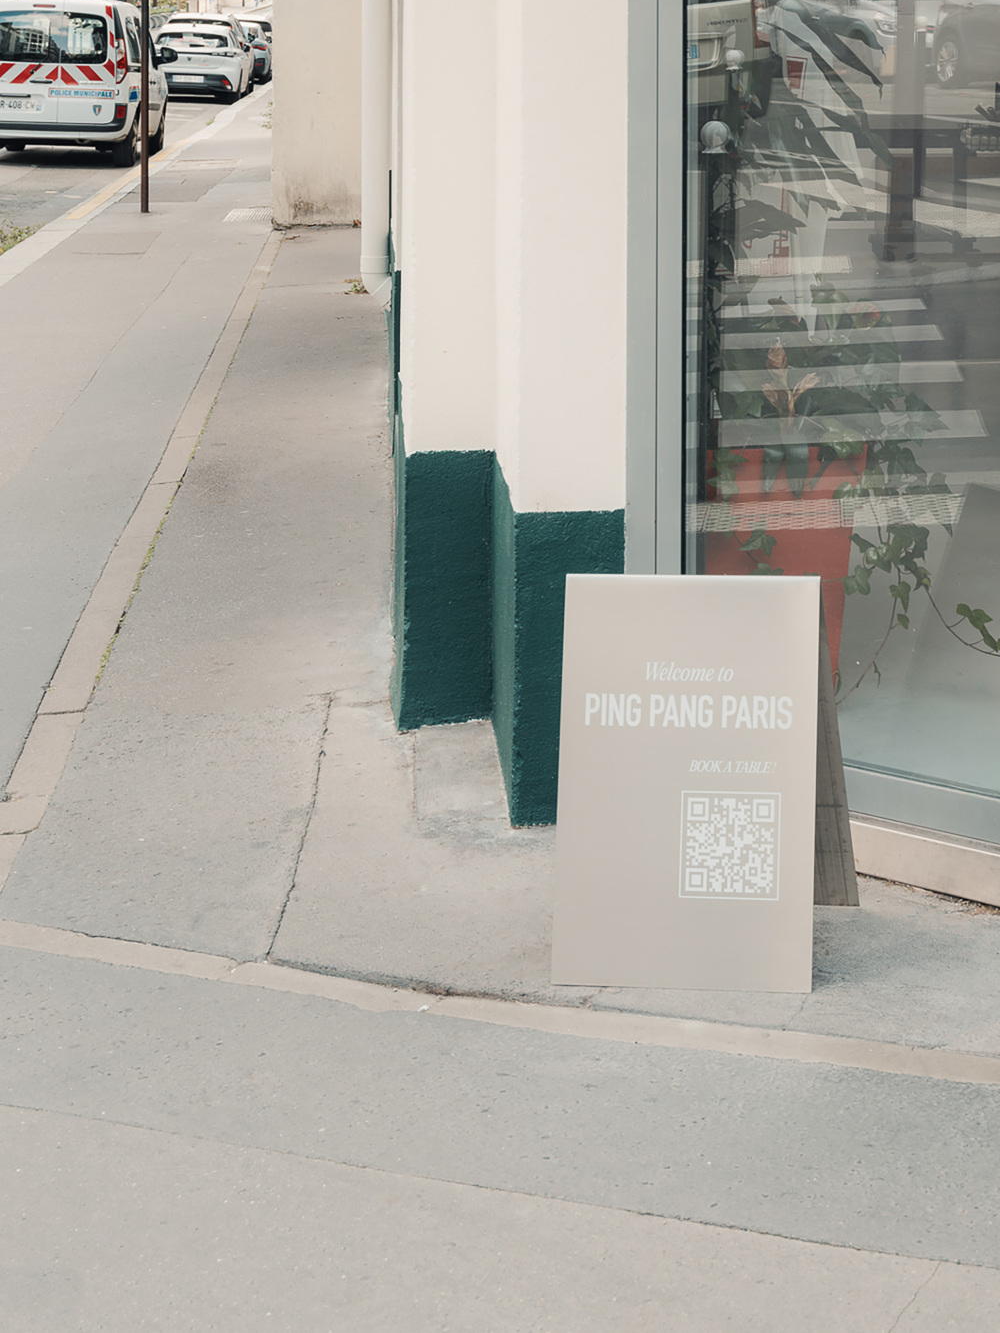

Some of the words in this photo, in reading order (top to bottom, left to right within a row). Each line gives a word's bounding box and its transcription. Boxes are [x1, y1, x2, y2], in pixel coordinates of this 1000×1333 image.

[50, 89, 72, 97] POLICE
[74, 90, 113, 98] MUNICIPALE
[645, 662, 715, 682] Welcome
[717, 666, 734, 682] to
[584, 692, 642, 727] PING
[650, 694, 714, 728] PANG
[721, 695, 793, 730] PARIS
[689, 760, 722, 773] BOOK
[722, 760, 732, 773] A
